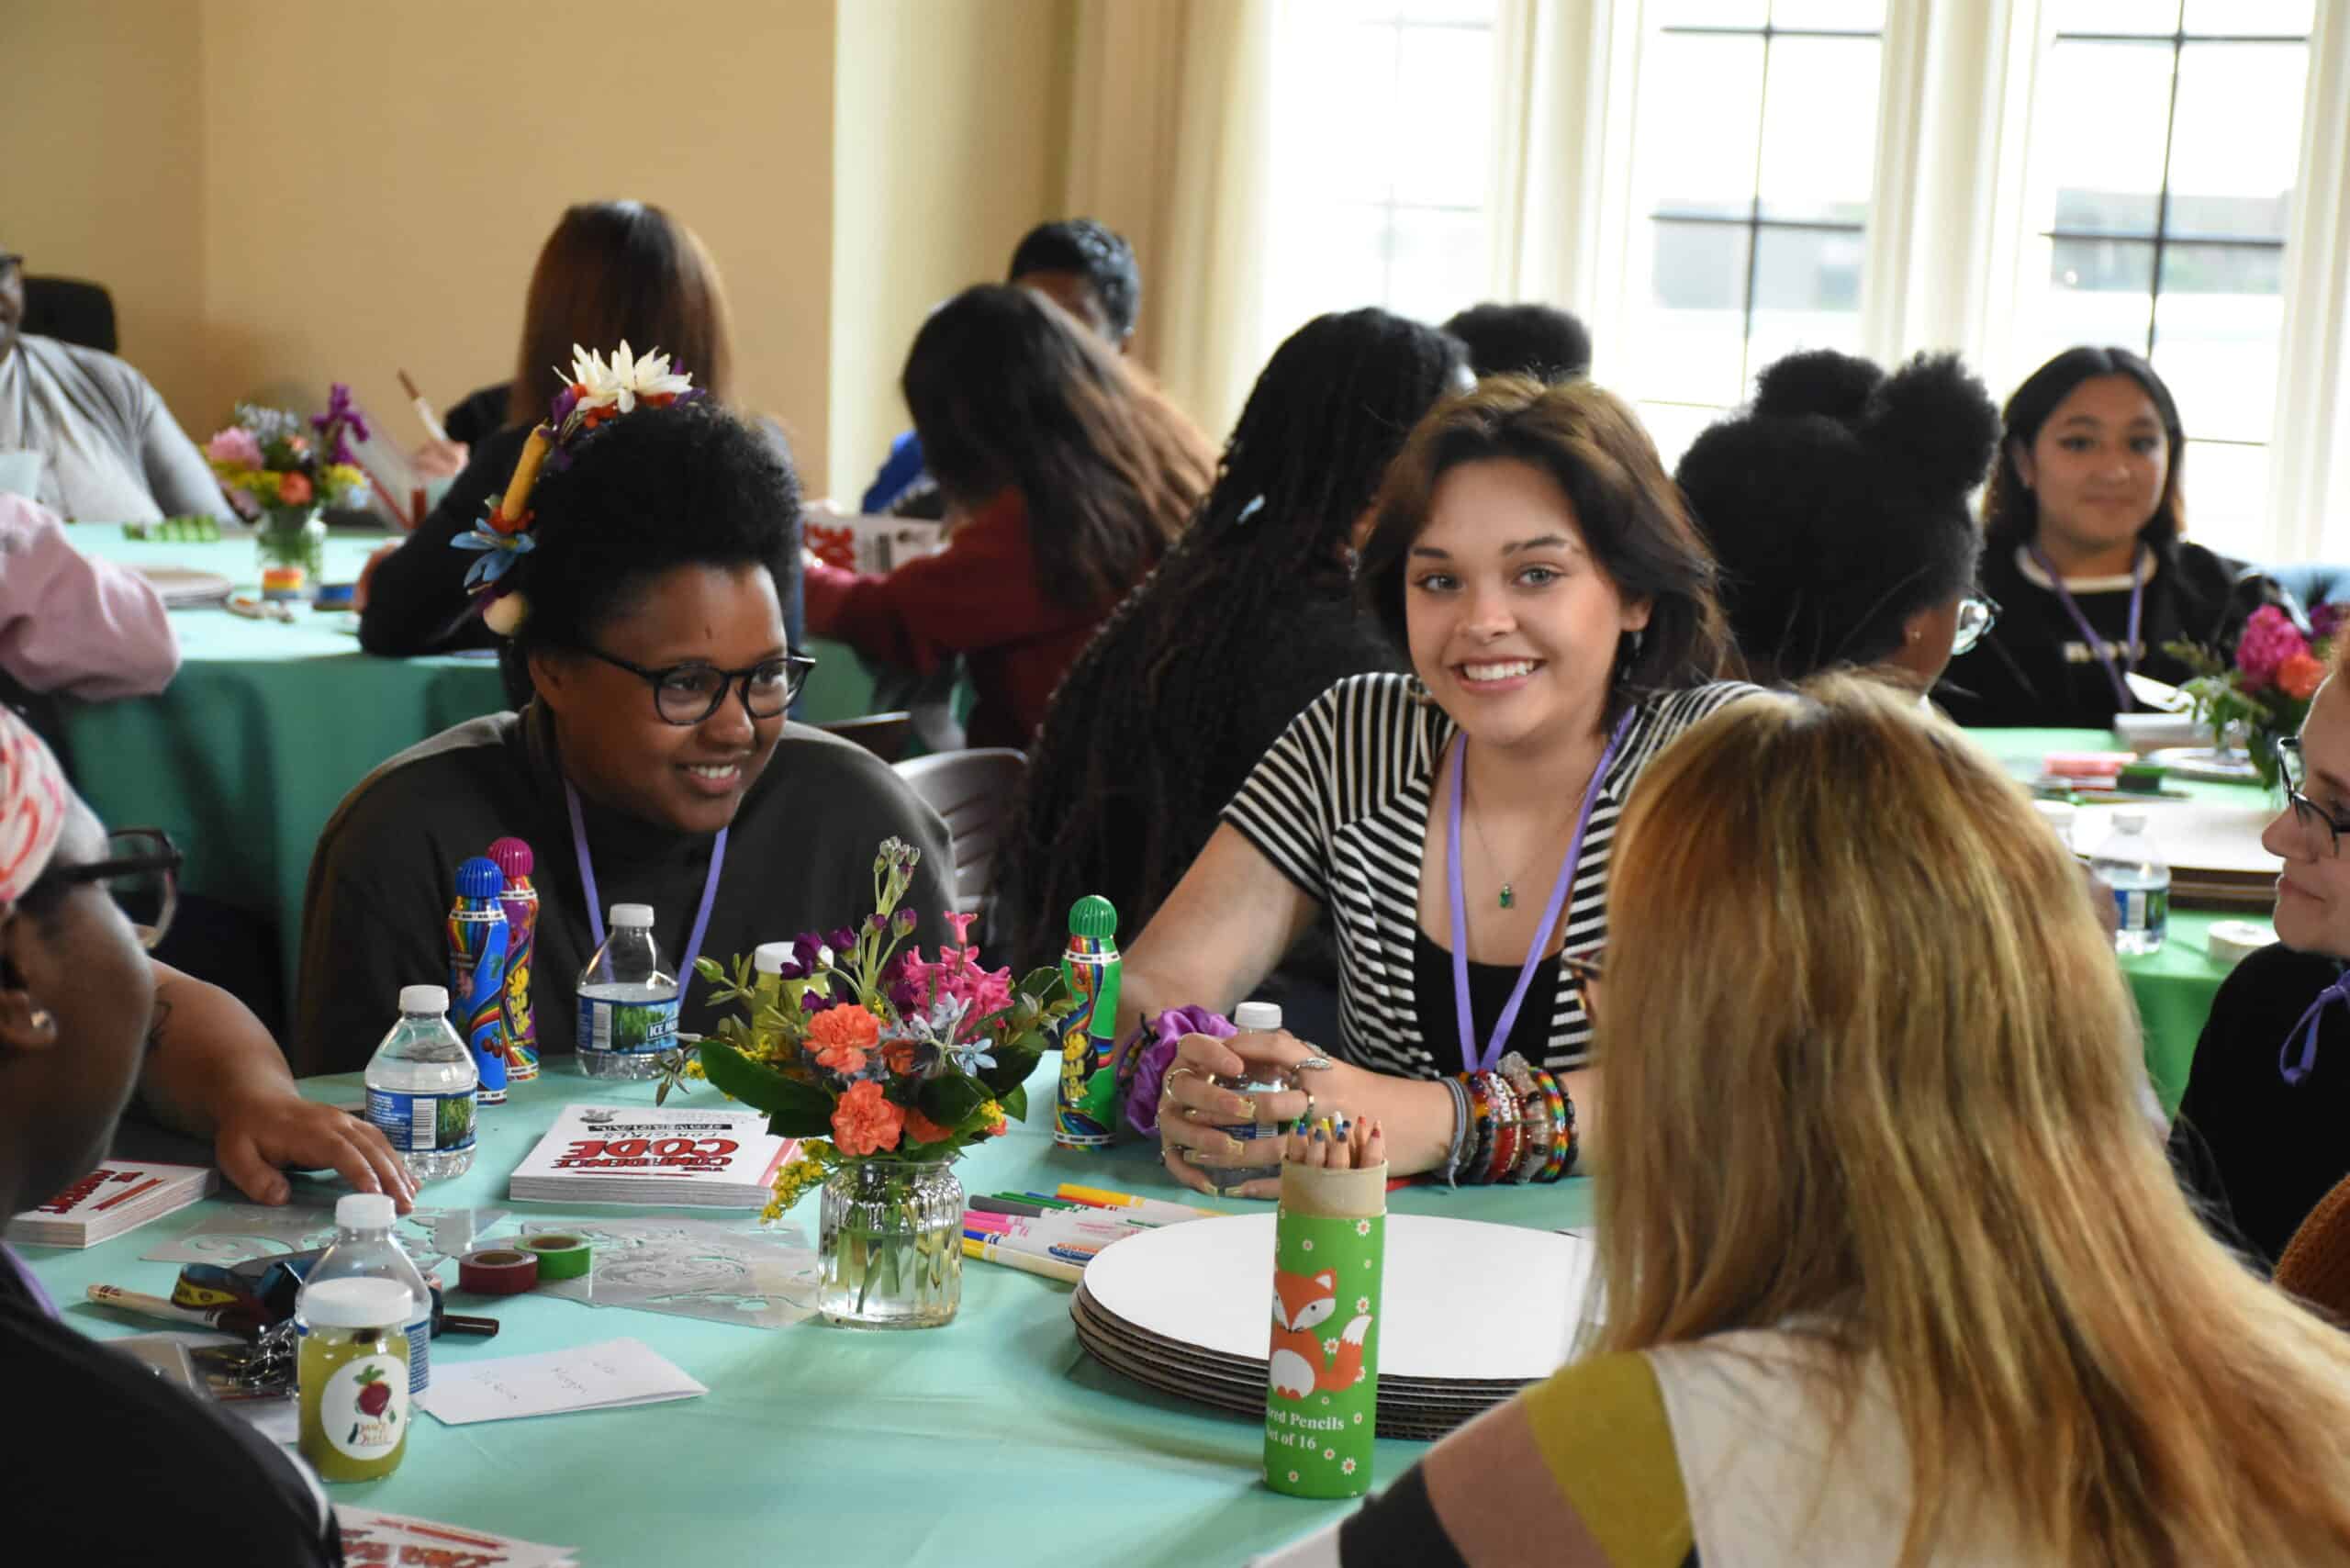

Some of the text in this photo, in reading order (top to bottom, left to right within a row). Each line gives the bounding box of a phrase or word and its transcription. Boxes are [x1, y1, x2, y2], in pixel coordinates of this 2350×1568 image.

[649, 1023, 664, 1037] ICE
[561, 1137, 740, 1159] CODE
[550, 1157, 733, 1170] CONFIDENCE
[1290, 1412, 1345, 1430] Pencils
[1281, 1432, 1295, 1446] of
[1300, 1435, 1317, 1450] 16
